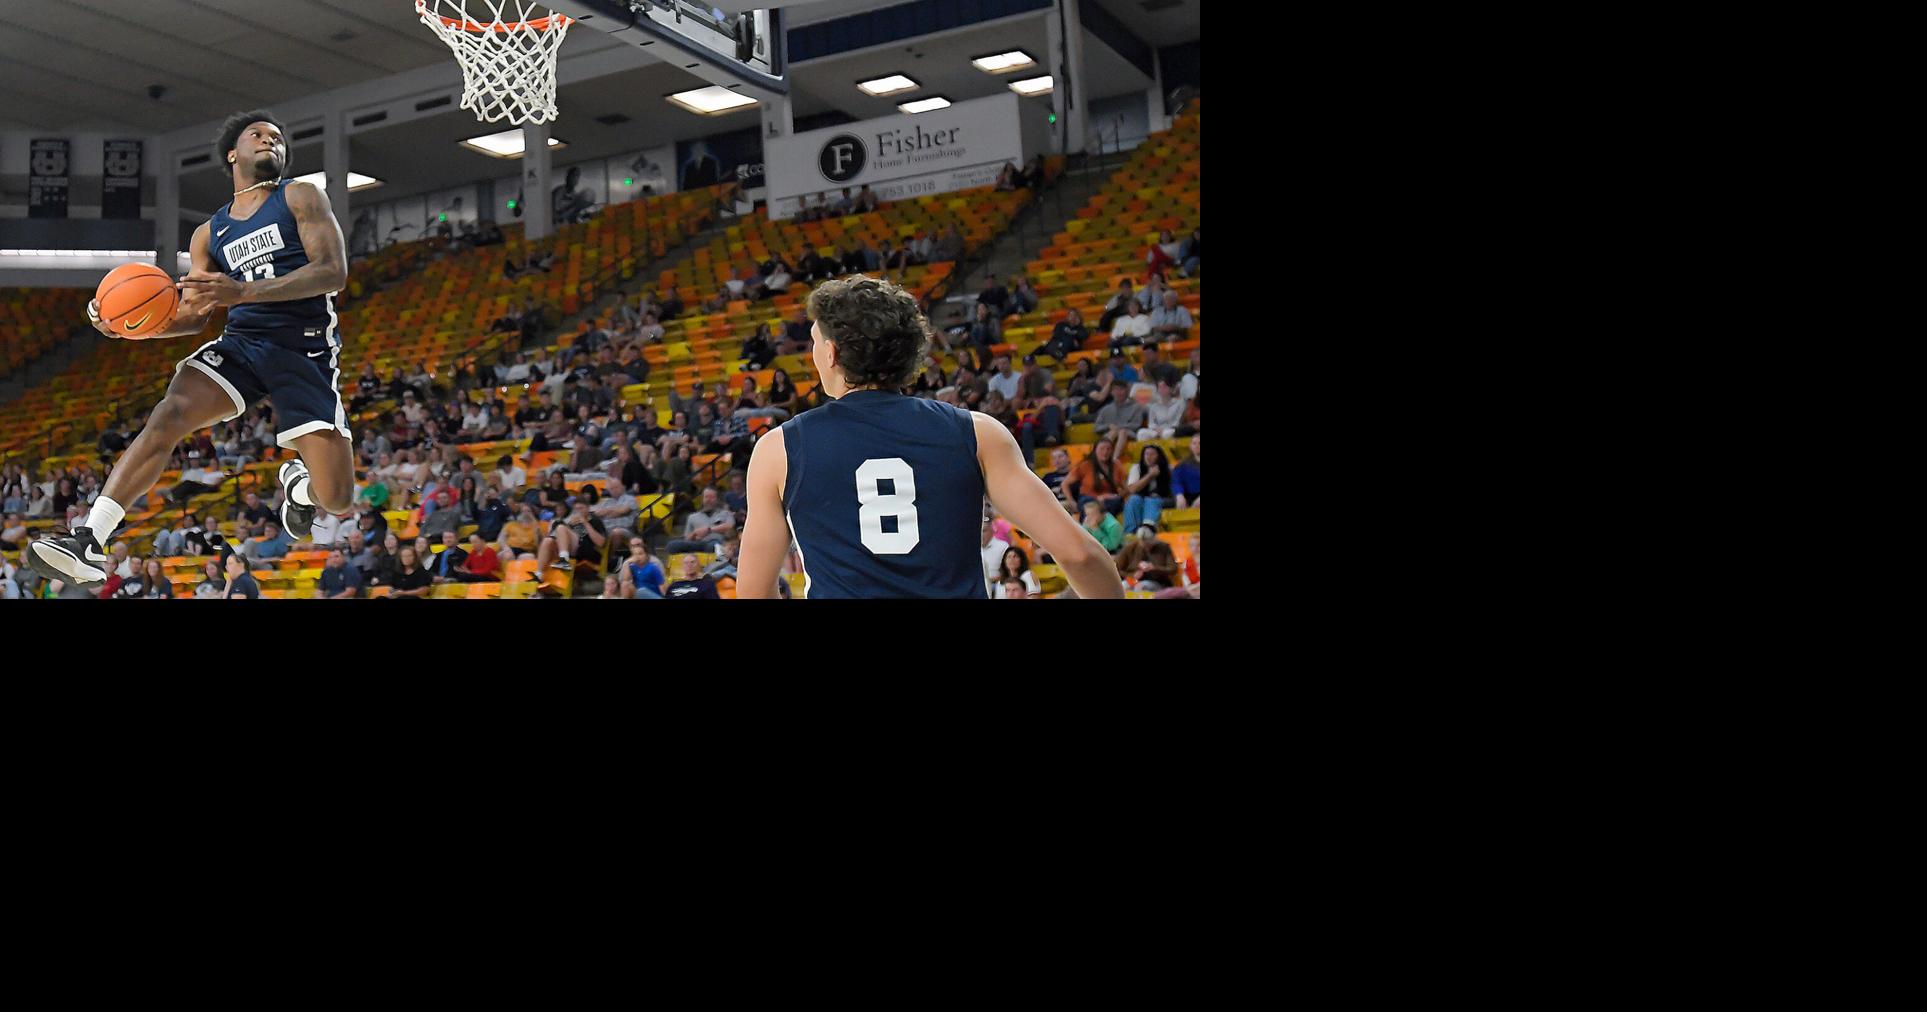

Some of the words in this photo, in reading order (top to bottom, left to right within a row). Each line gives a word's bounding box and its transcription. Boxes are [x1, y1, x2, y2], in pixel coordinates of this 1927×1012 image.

[875, 124, 960, 156] Fisher
[831, 143, 853, 175] F
[229, 240, 250, 263] UTAH
[250, 230, 277, 253] STATE
[855, 458, 920, 554] 8
